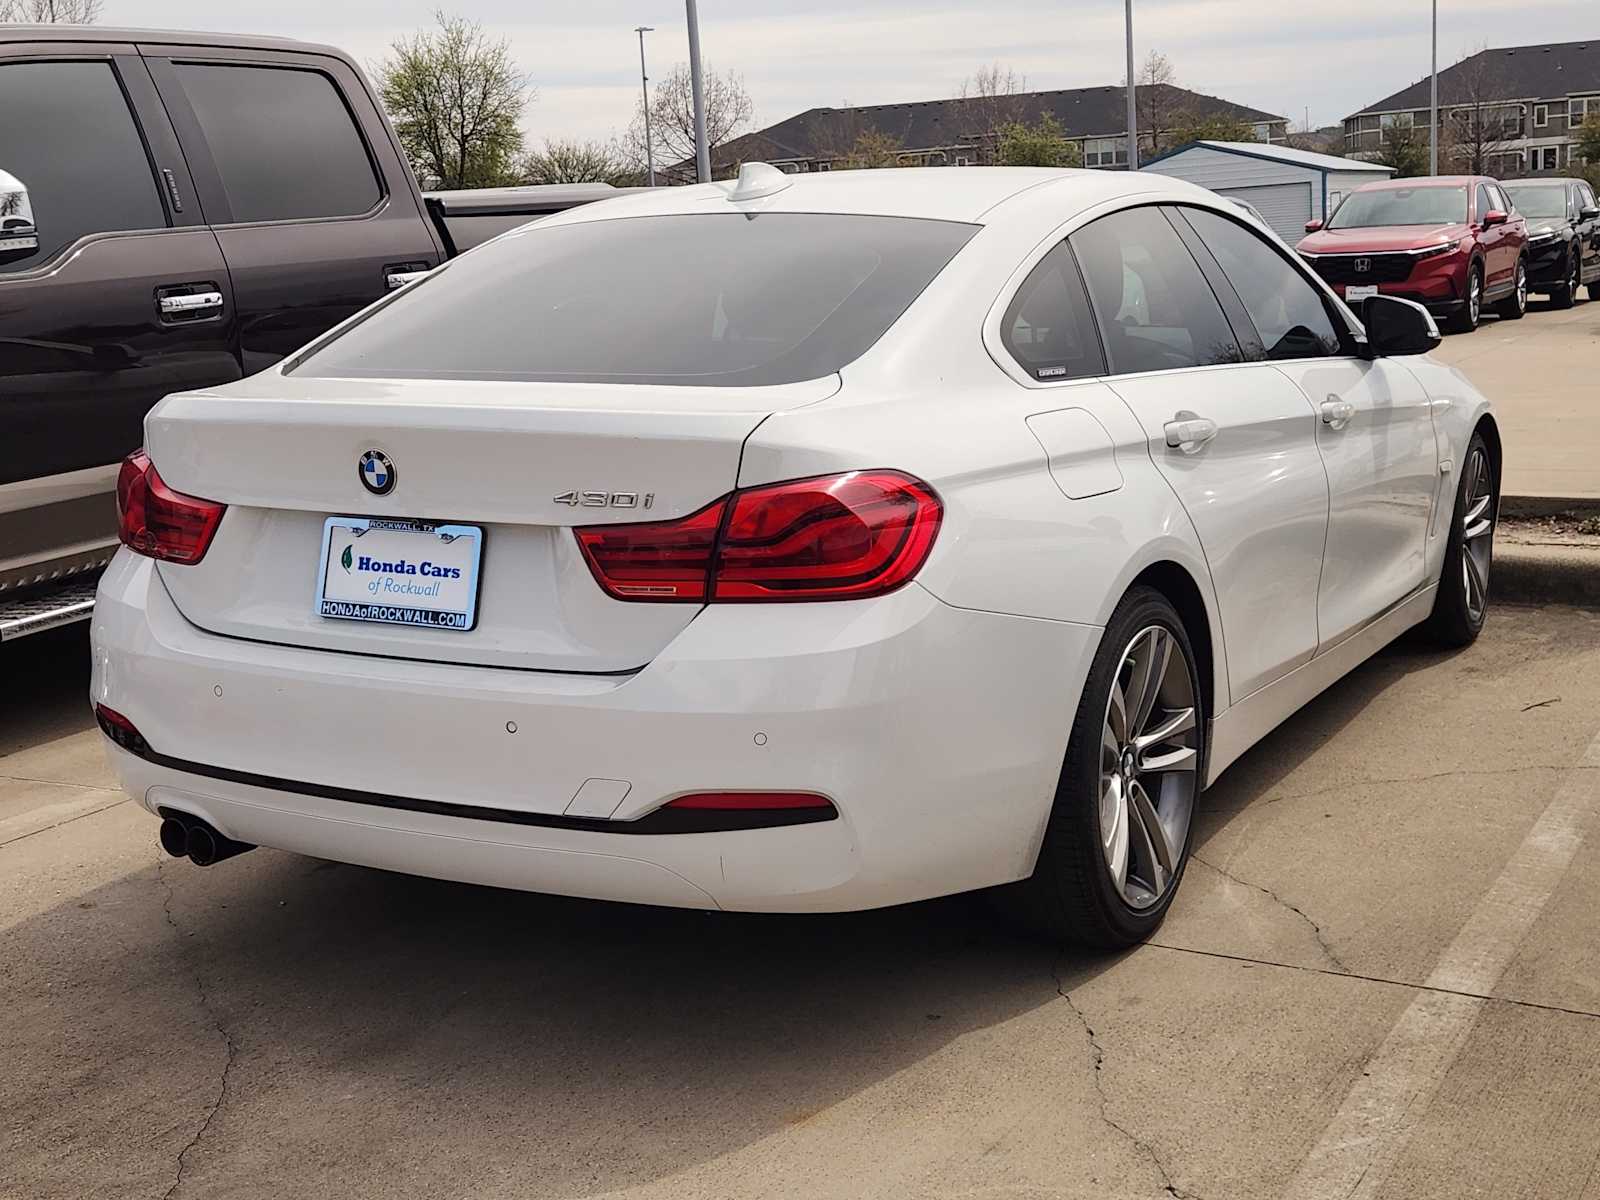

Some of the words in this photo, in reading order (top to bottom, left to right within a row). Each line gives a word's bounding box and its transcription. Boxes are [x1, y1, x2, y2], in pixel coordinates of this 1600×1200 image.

[358, 556, 416, 575] Honda
[420, 562, 460, 578] Cars
[368, 577, 383, 595] of
[384, 578, 440, 596] Rockwall
[322, 602, 465, 627] HONDAofROCKWALL.COM
